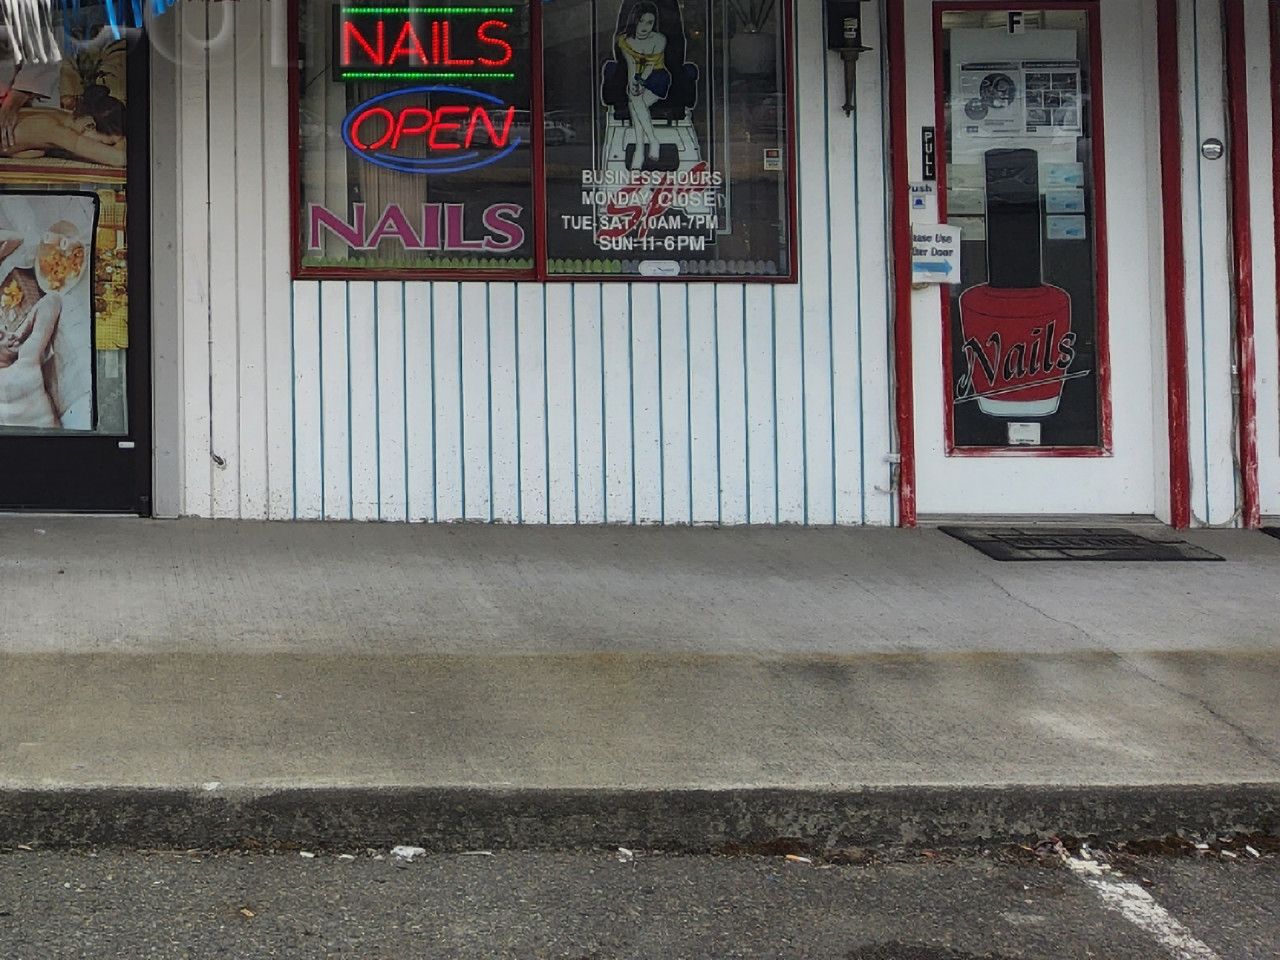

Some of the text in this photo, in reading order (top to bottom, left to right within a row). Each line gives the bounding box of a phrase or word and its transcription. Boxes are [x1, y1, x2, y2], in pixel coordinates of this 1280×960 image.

[340, 19, 513, 67] NAILS
[1008, 12, 1022, 33] F
[350, 104, 515, 151] OPEN
[924, 131, 933, 177] PULL
[581, 169, 722, 186] BUSINESS HOURS
[908, 184, 932, 193] ush
[307, 203, 526, 252] NAILS
[957, 320, 1077, 398] Nails
